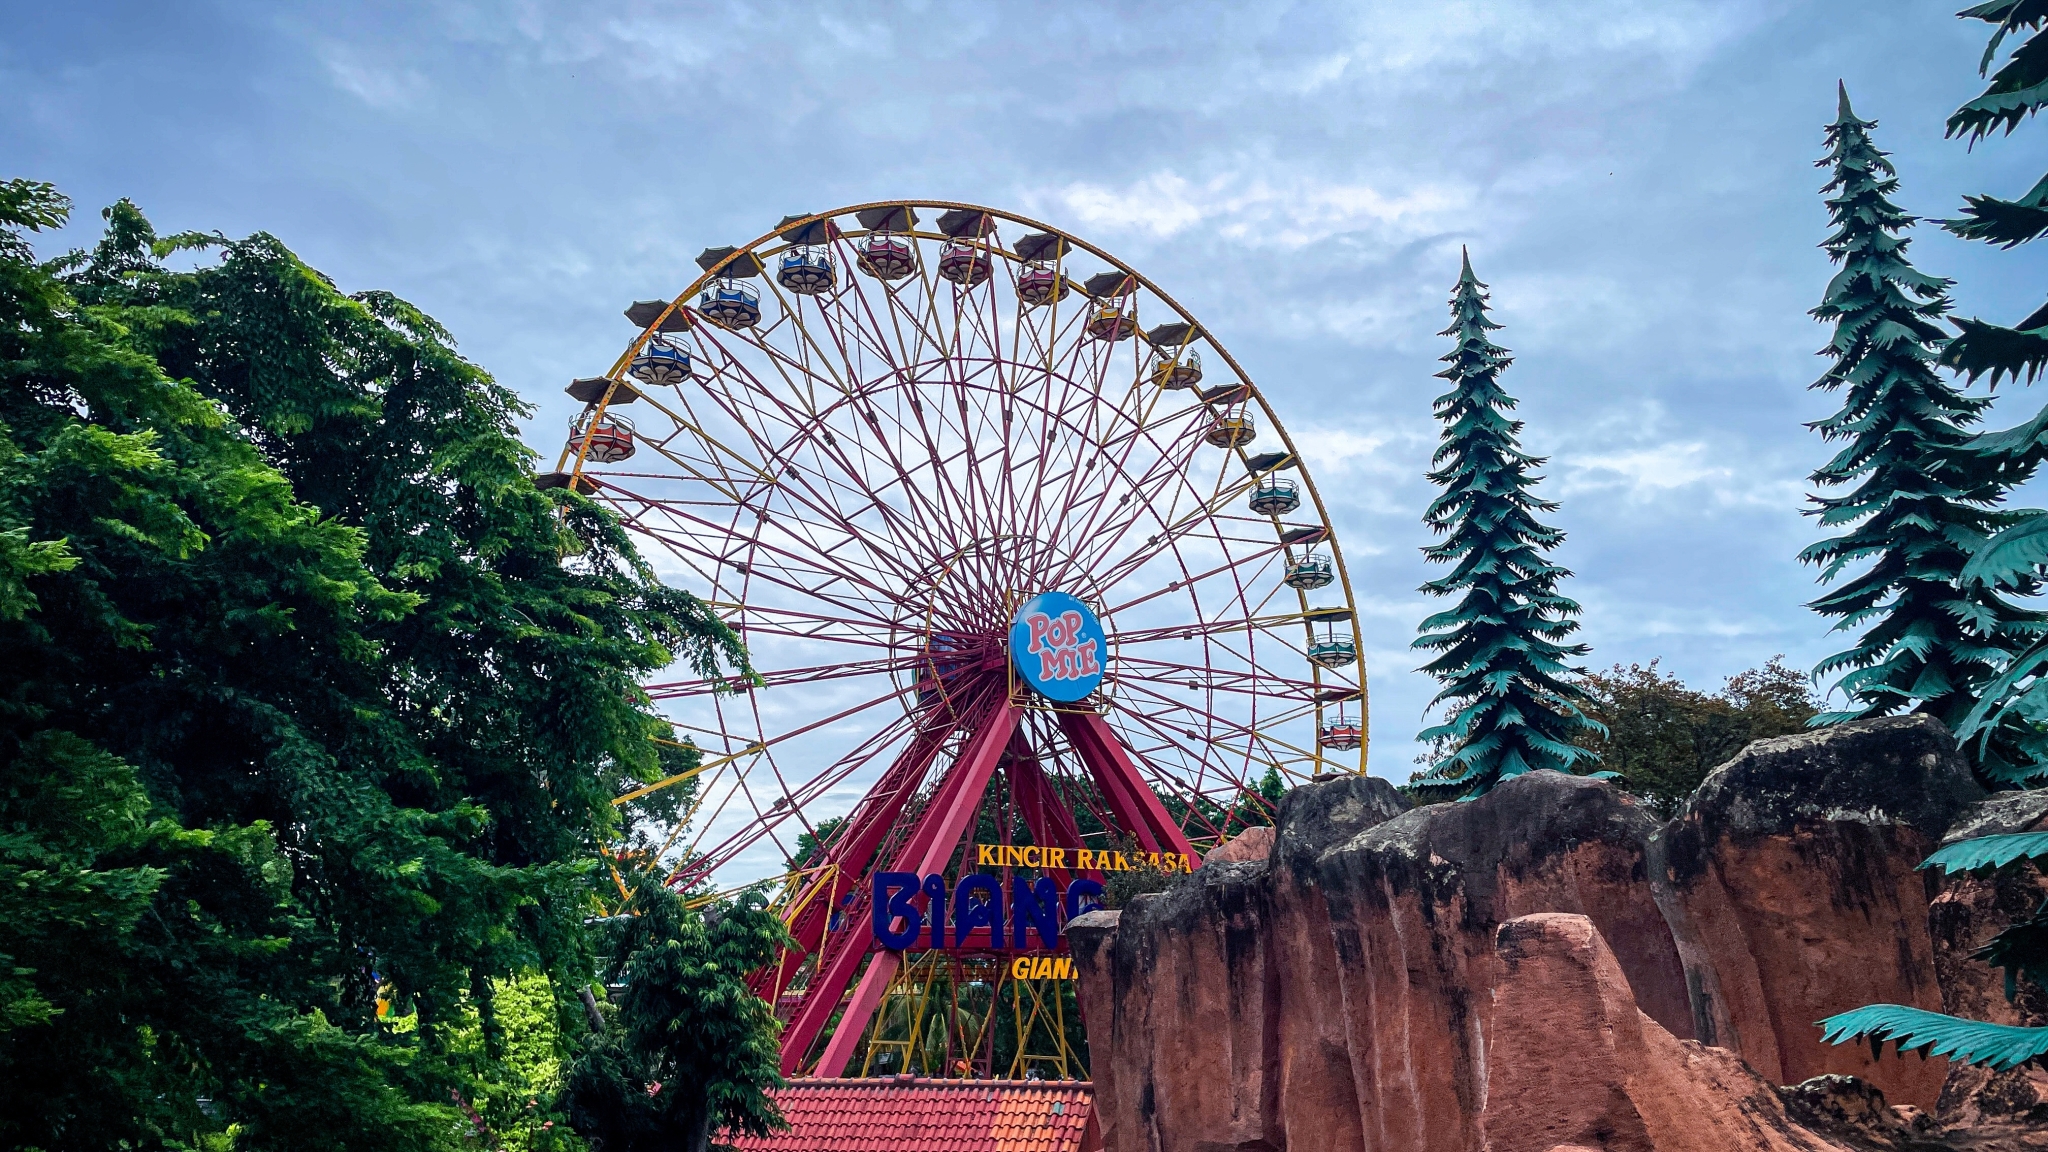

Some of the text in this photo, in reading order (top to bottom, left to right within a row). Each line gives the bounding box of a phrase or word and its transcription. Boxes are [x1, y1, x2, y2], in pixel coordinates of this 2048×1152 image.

[1025, 610, 1083, 654] POP
[1039, 638, 1100, 682] MIE
[977, 844, 1065, 869] KINCIR
[1012, 956, 1079, 980] GIAN
